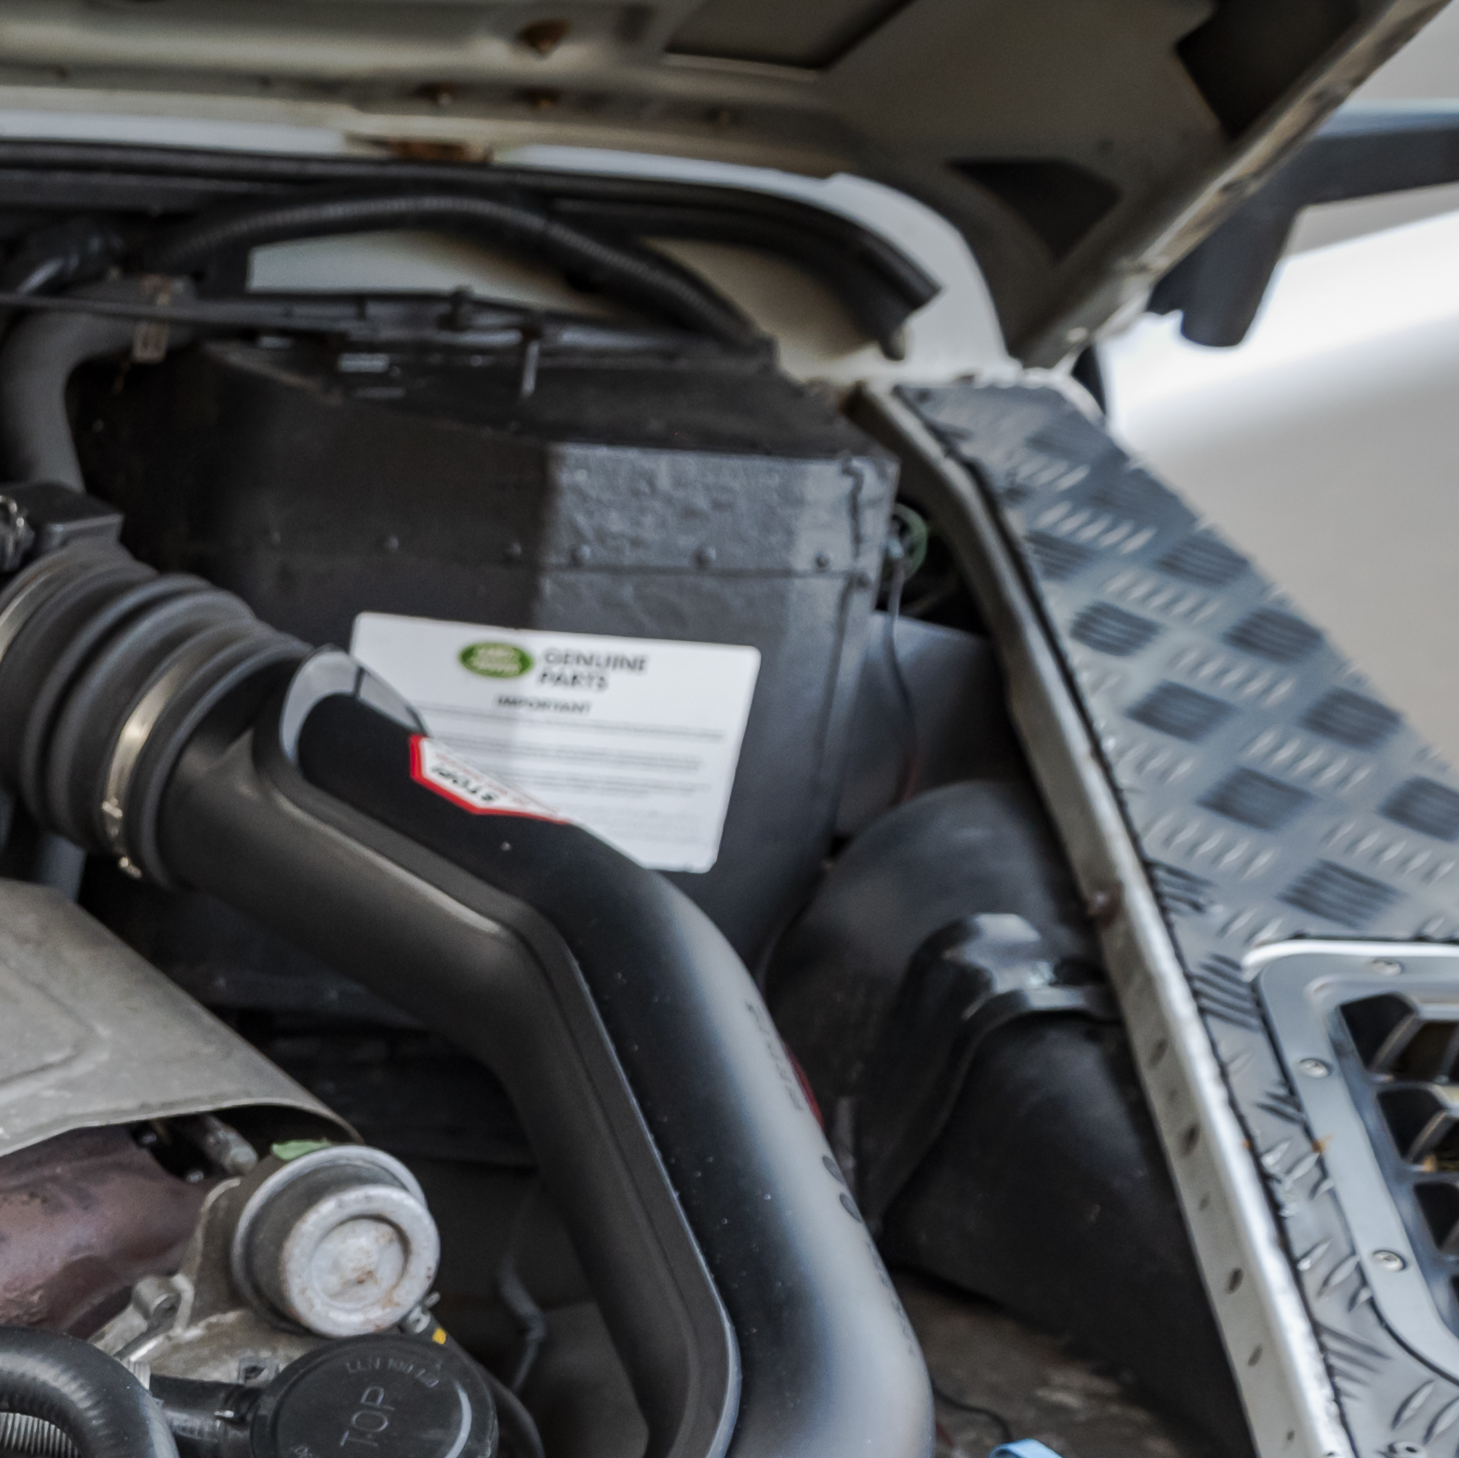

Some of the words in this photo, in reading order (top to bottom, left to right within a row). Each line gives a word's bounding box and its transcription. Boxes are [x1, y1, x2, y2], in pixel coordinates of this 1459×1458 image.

[544, 649, 648, 671] GENUINE
[540, 671, 608, 690] PARTS
[497, 695, 591, 714] IMPORTANT
[340, 1386, 395, 1448] TOP
